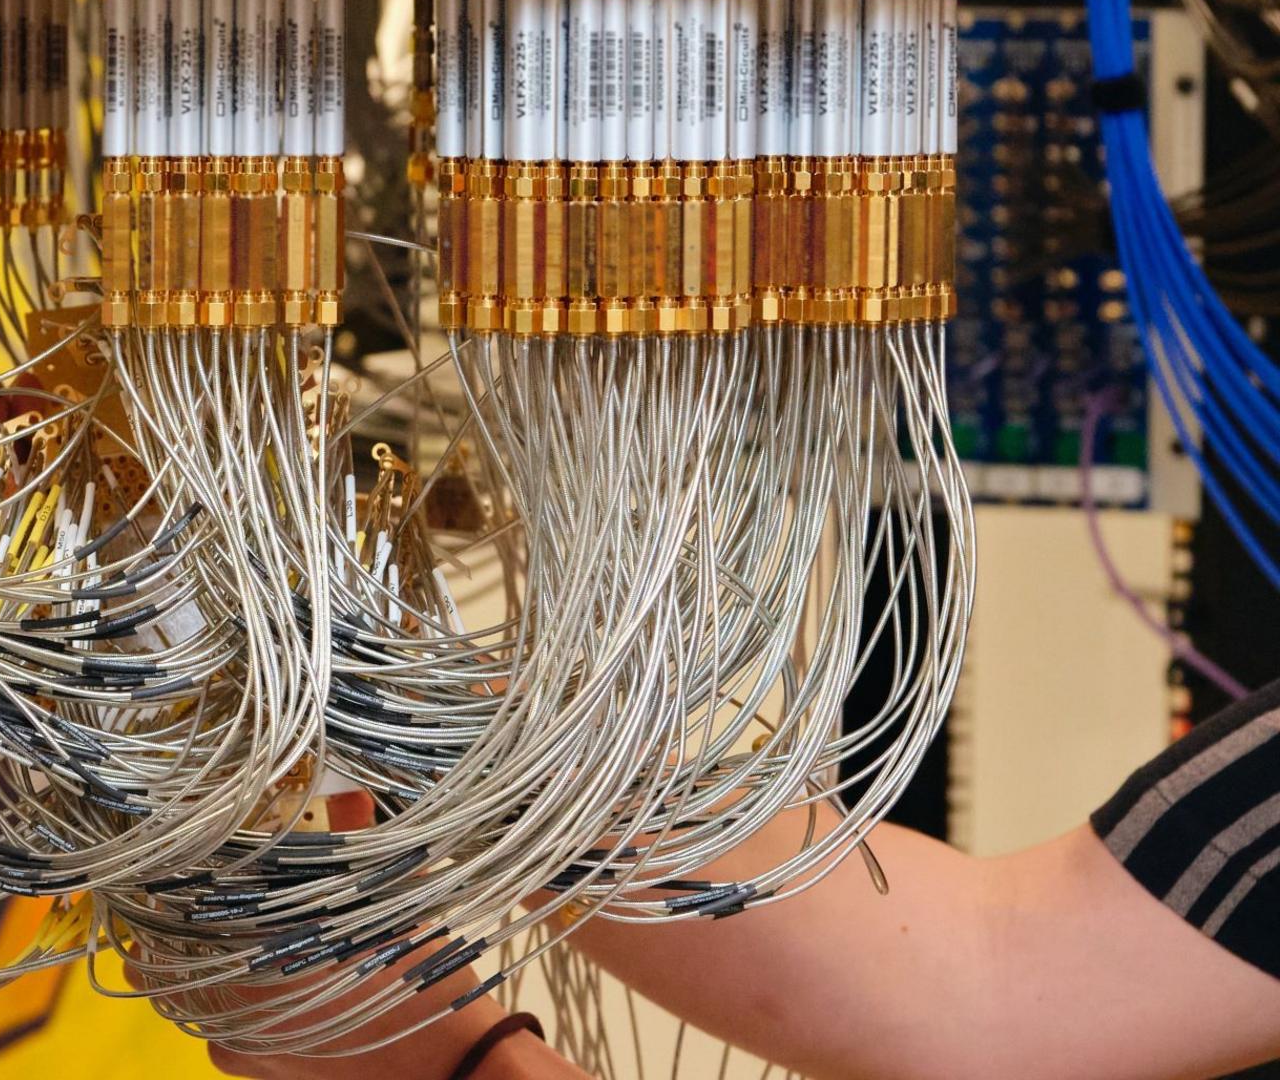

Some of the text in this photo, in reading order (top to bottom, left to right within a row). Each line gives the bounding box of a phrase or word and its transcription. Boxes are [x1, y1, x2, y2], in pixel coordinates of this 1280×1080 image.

[181, 28, 191, 115] VLFX-225+
[216, 22, 226, 100] Mini-Circuits
[288, 23, 298, 100] Mini-Circuits
[492, 25, 501, 103] Mini-Circuits
[516, 31, 526, 118] VLFX-225+
[739, 27, 749, 105] Mini-Circuits
[818, 31, 828, 116] VLFX-225+
[868, 31, 878, 115] VLFX-225+
[906, 31, 916, 115] VLFX-225+
[947, 26, 955, 101] Mini-Circuits
